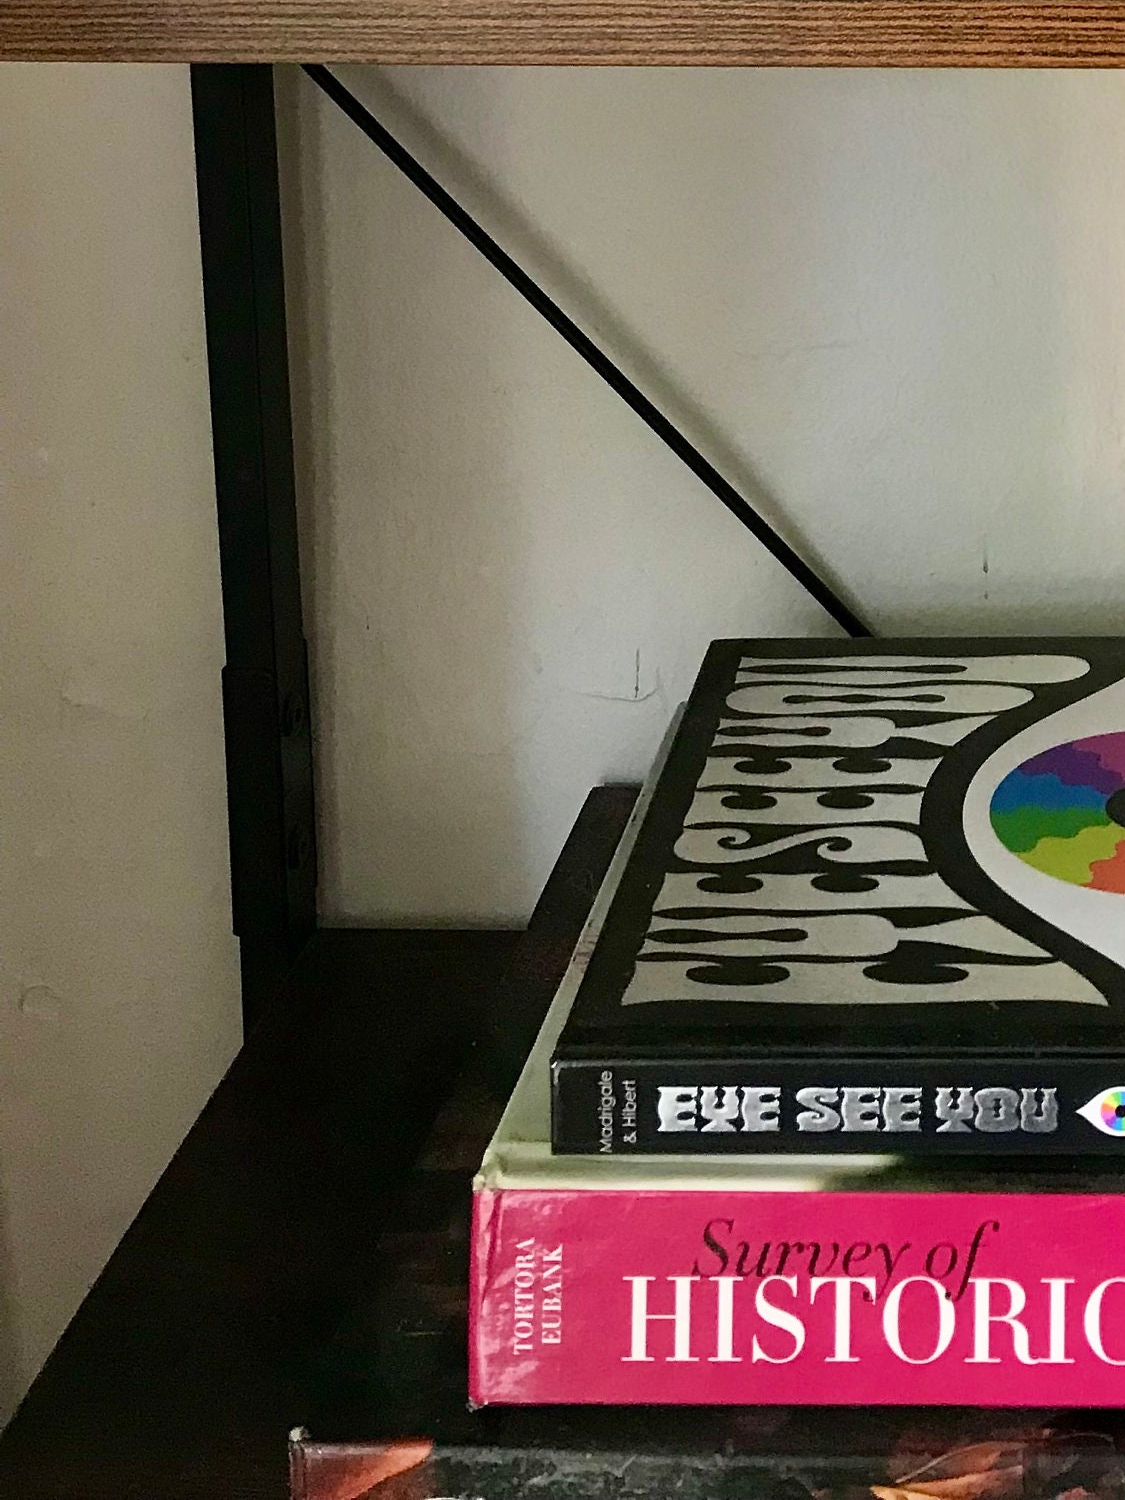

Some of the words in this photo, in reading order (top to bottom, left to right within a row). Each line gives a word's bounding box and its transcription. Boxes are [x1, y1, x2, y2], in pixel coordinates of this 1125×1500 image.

[713, 654, 1091, 750] YOU
[674, 755, 948, 864] SEE
[621, 872, 1110, 1007] EYE
[598, 1070, 616, 1153] Madrigale
[622, 1079, 637, 1127] Hibert
[623, 1130, 637, 1144] &
[657, 1086, 781, 1132] EYE
[796, 1086, 923, 1133] SEE
[935, 1086, 1060, 1133] YOU
[512, 1238, 535, 1355] TORTORA
[541, 1245, 564, 1345] EUBANK
[692, 1218, 912, 1302] Survey
[925, 1221, 1000, 1301] of
